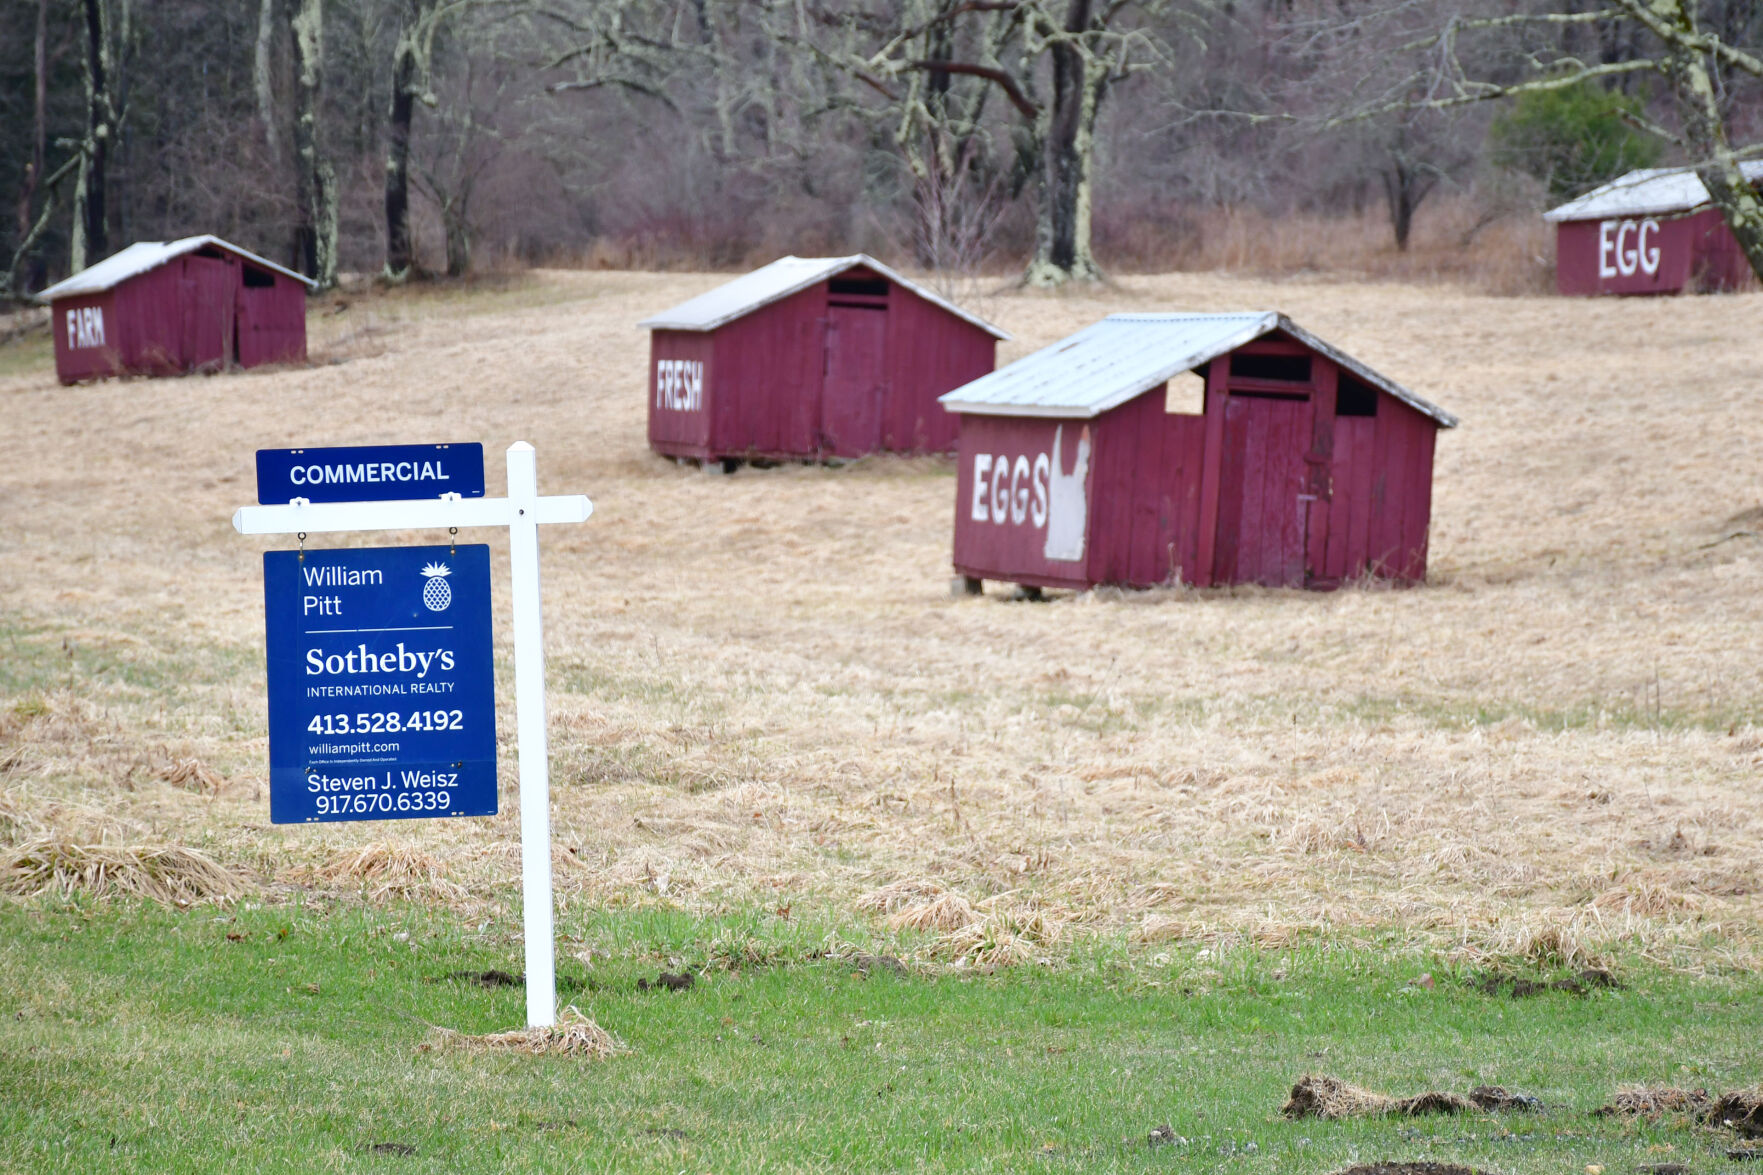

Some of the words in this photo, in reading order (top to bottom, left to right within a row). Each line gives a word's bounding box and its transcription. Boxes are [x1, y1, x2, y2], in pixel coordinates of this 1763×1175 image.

[1598, 218, 1661, 279] EGG
[66, 306, 105, 350] FARM
[657, 359, 704, 412] FRESH
[290, 461, 450, 485] COMMERCIAL
[971, 452, 1050, 528] EGGS
[303, 566, 383, 587] William
[303, 595, 343, 616] Pitt
[306, 643, 455, 679] Sotheby's
[307, 684, 408, 698] INTERNATIONAL
[410, 682, 455, 694] REALTY
[307, 709, 464, 735] 413.528.4192
[308, 742, 400, 755] williampitt.com
[307, 774, 376, 793] Steven
[381, 771, 397, 790] J.
[400, 770, 459, 789] Weisz
[316, 790, 451, 815] 917.670.6339
